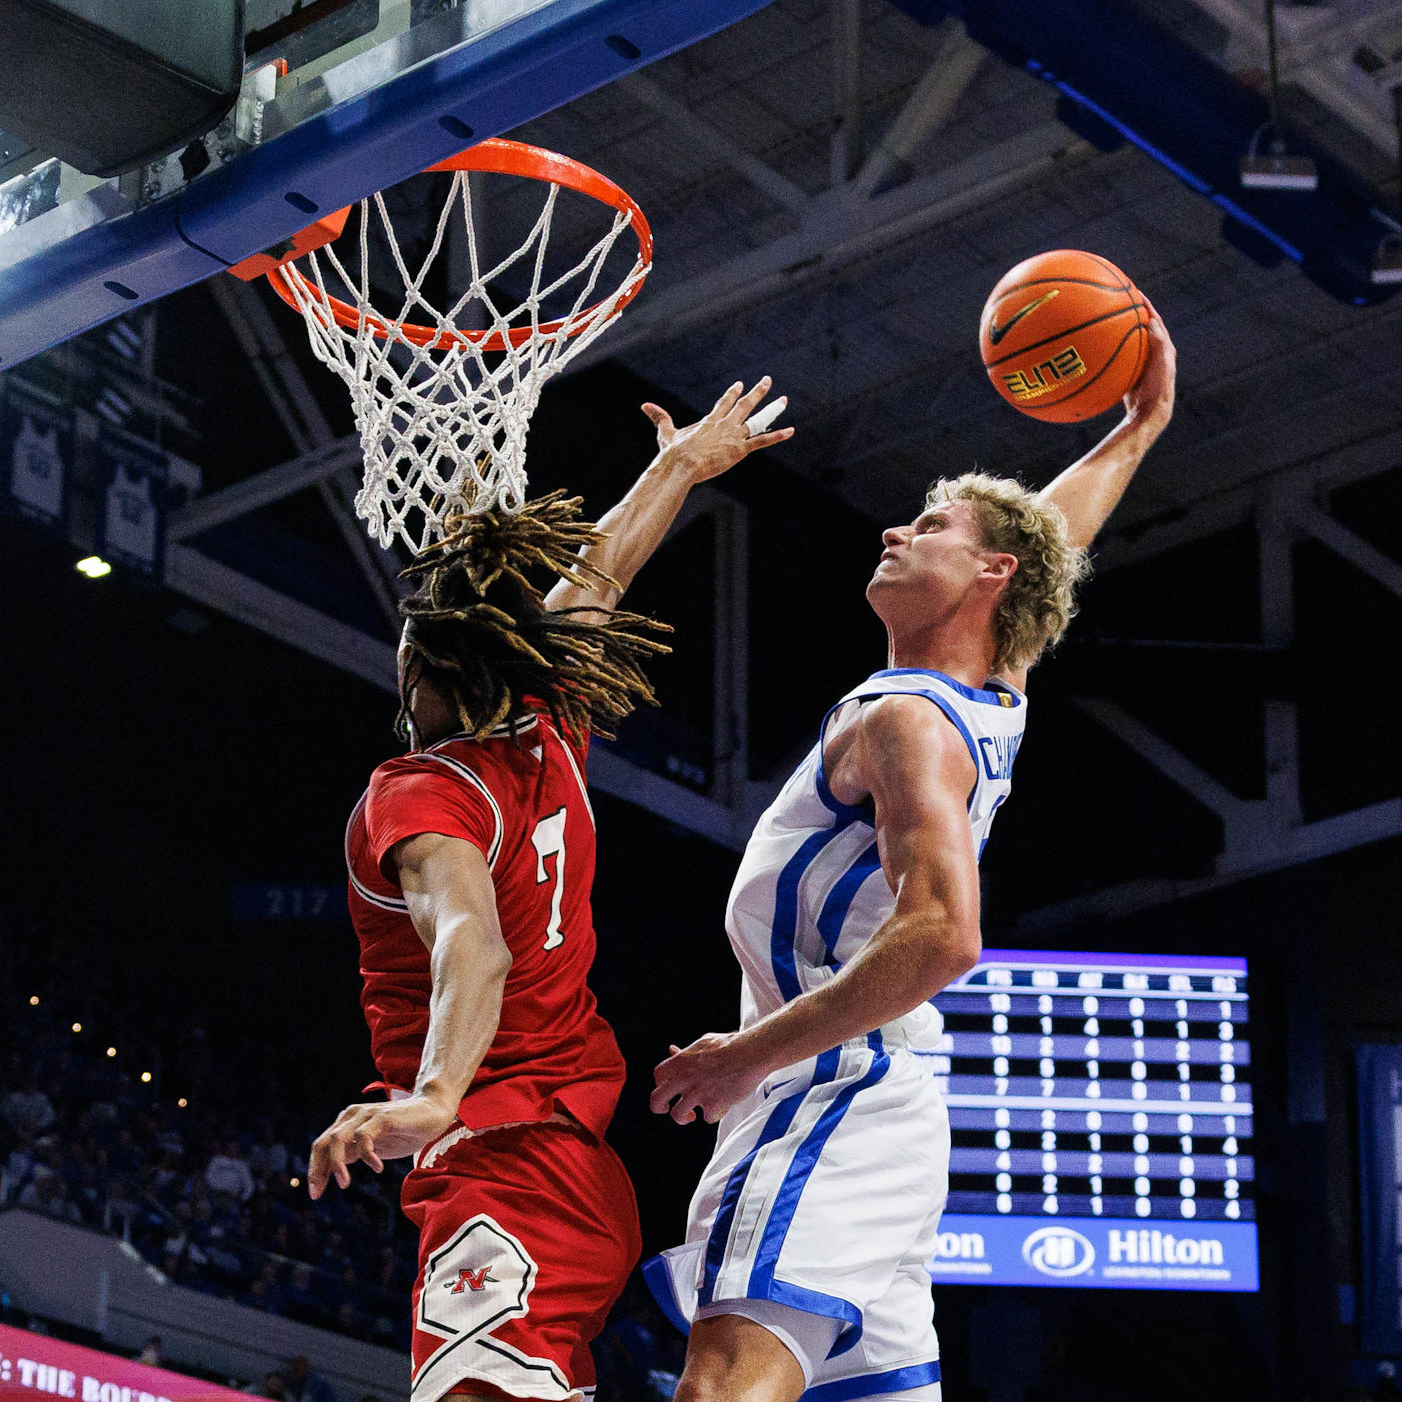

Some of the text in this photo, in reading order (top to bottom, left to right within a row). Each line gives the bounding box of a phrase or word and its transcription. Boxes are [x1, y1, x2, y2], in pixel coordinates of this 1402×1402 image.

[1002, 347, 1084, 395] ELITE
[531, 805, 568, 951] 7
[1108, 1229, 1225, 1266] Hilton
[17, 1358, 76, 1399] THE
